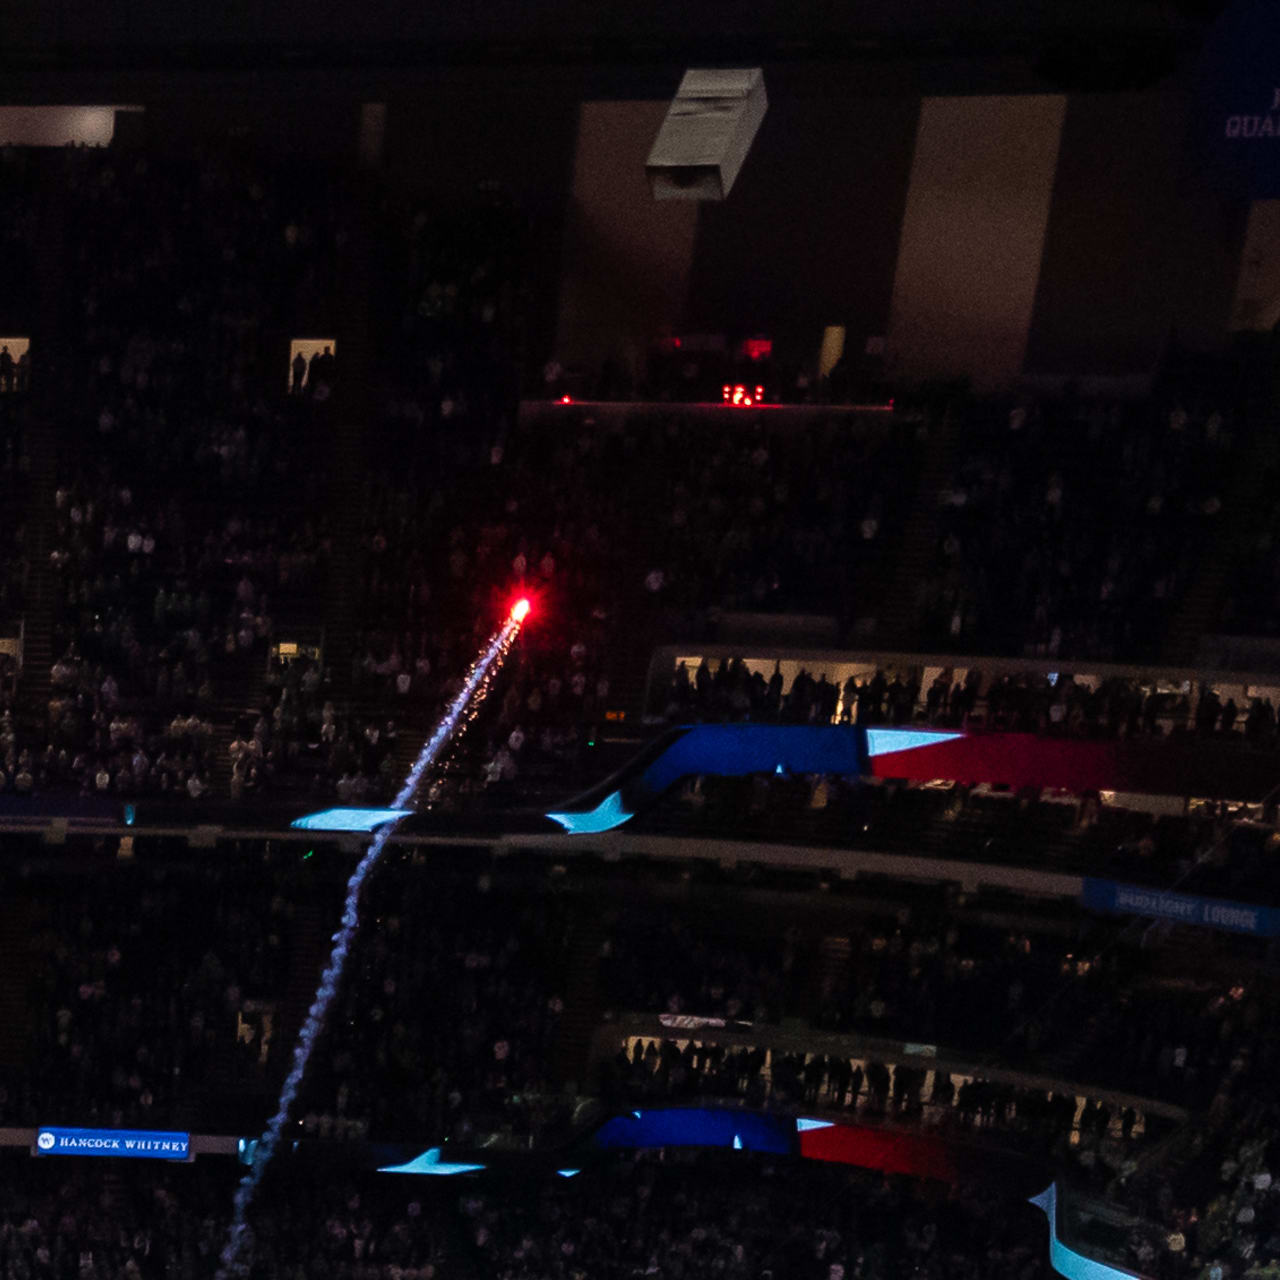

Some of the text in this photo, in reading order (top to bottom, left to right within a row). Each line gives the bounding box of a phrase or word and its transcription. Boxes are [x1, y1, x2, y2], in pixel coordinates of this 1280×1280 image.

[1225, 115, 1280, 137] QUA
[59, 1136, 188, 1152] HANCOCK WHITNEY
